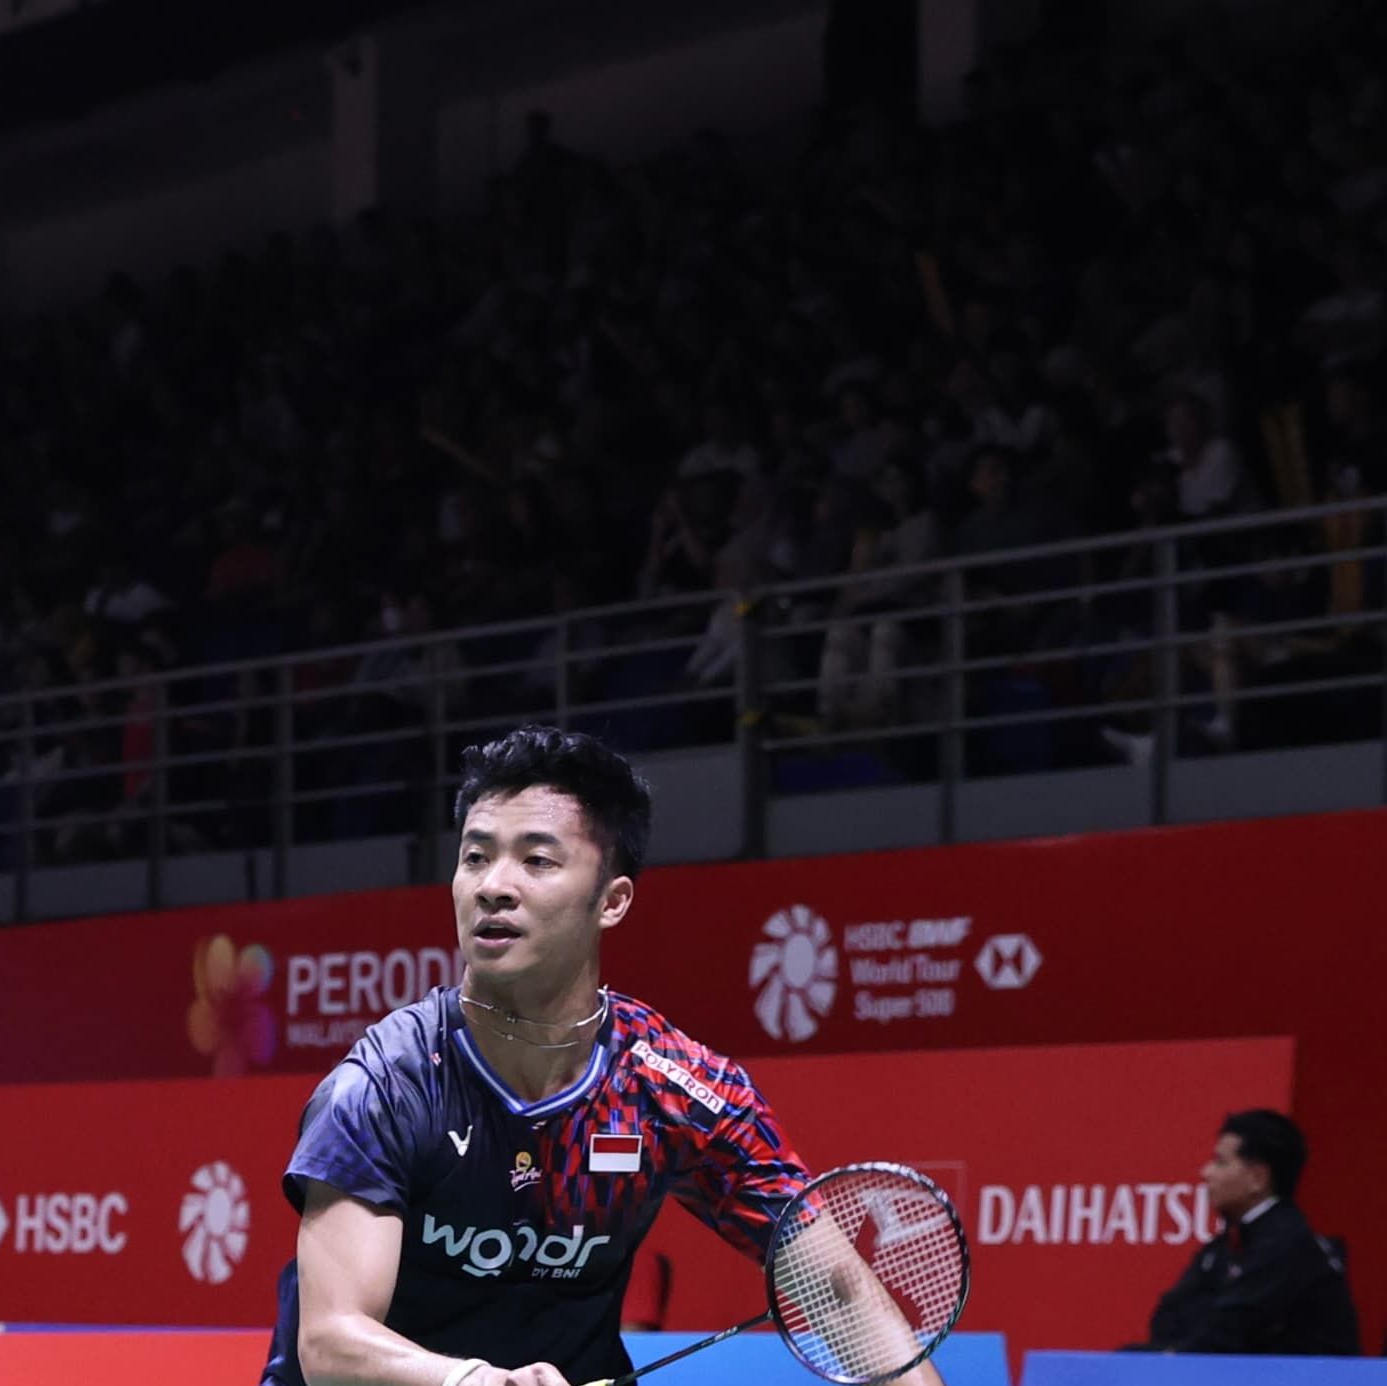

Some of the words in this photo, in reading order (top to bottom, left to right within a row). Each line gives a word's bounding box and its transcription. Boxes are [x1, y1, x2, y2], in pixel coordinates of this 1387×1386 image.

[850, 955, 912, 985] World
[912, 952, 961, 982] Tour
[854, 990, 913, 1024] Super
[15, 1192, 128, 1255] HSBC
